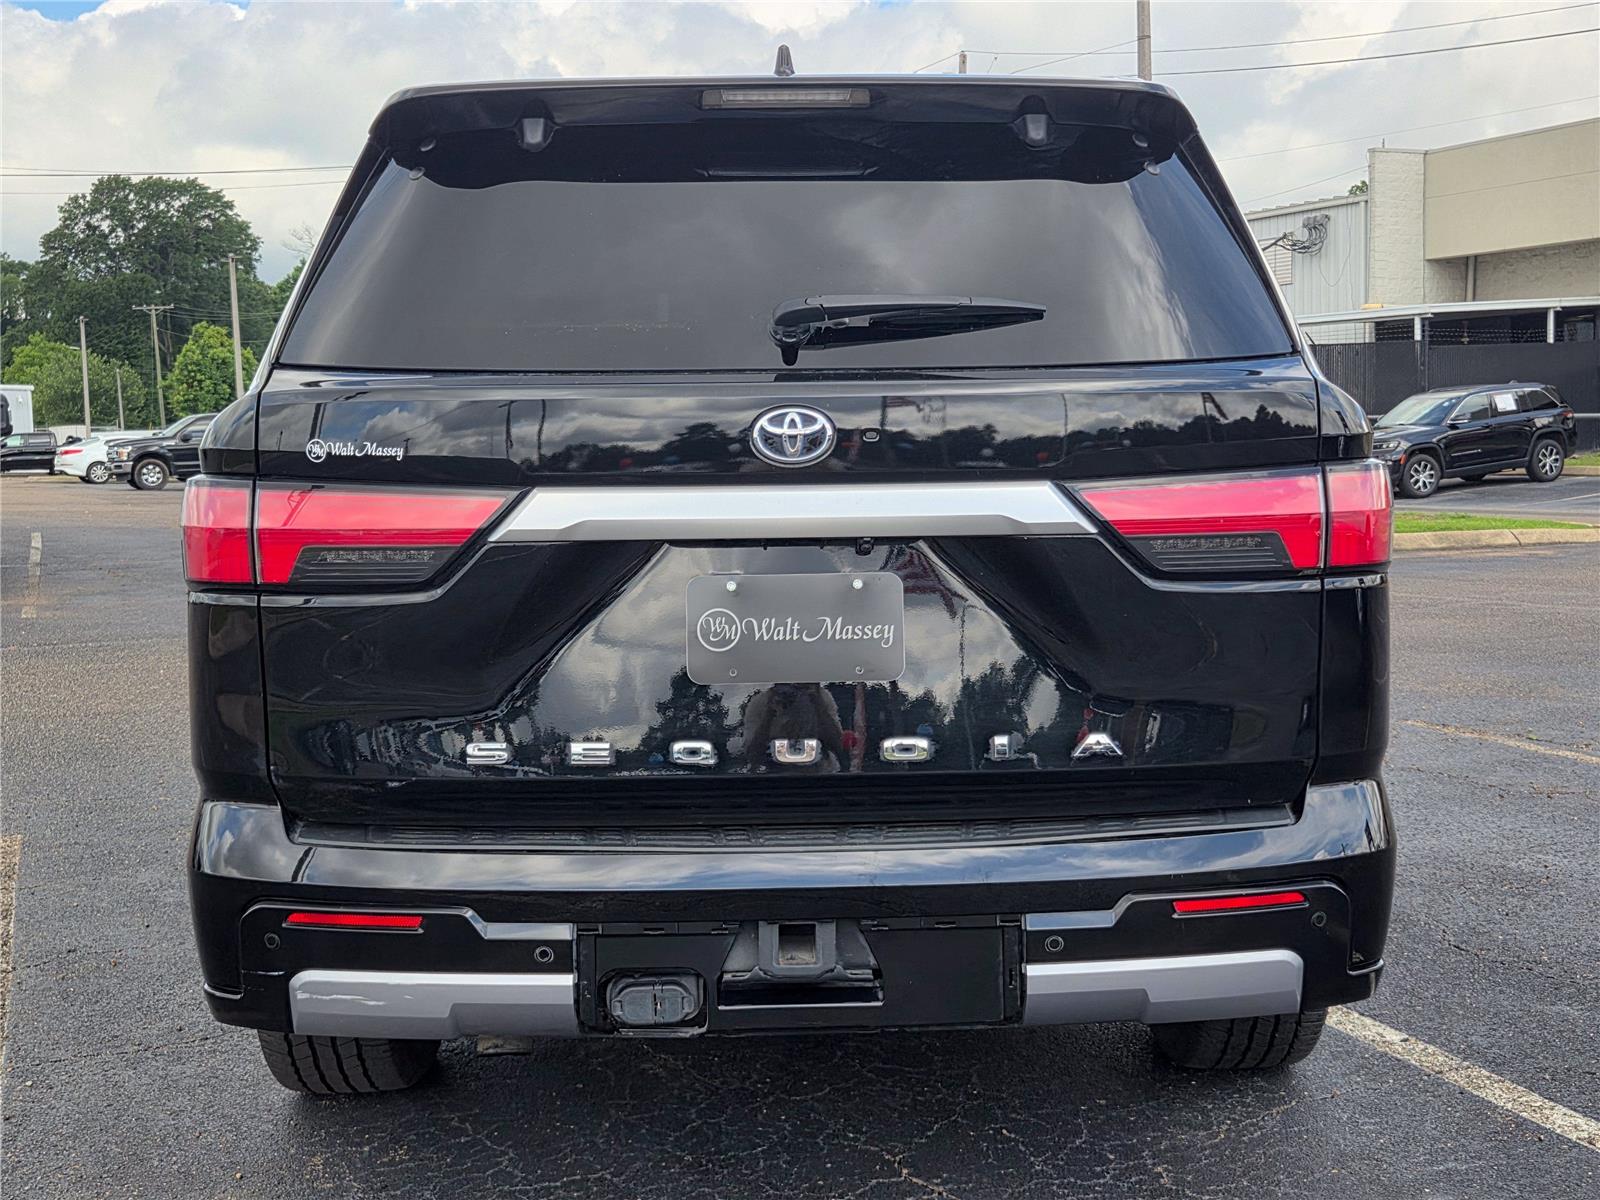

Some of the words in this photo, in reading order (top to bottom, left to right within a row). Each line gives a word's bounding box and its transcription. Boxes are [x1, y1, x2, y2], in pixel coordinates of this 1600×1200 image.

[325, 442, 355, 456] Walt
[355, 442, 404, 461] Massey
[742, 617, 800, 641] Walt
[802, 616, 895, 648] Massey
[466, 734, 1124, 765] SEQUOIA
